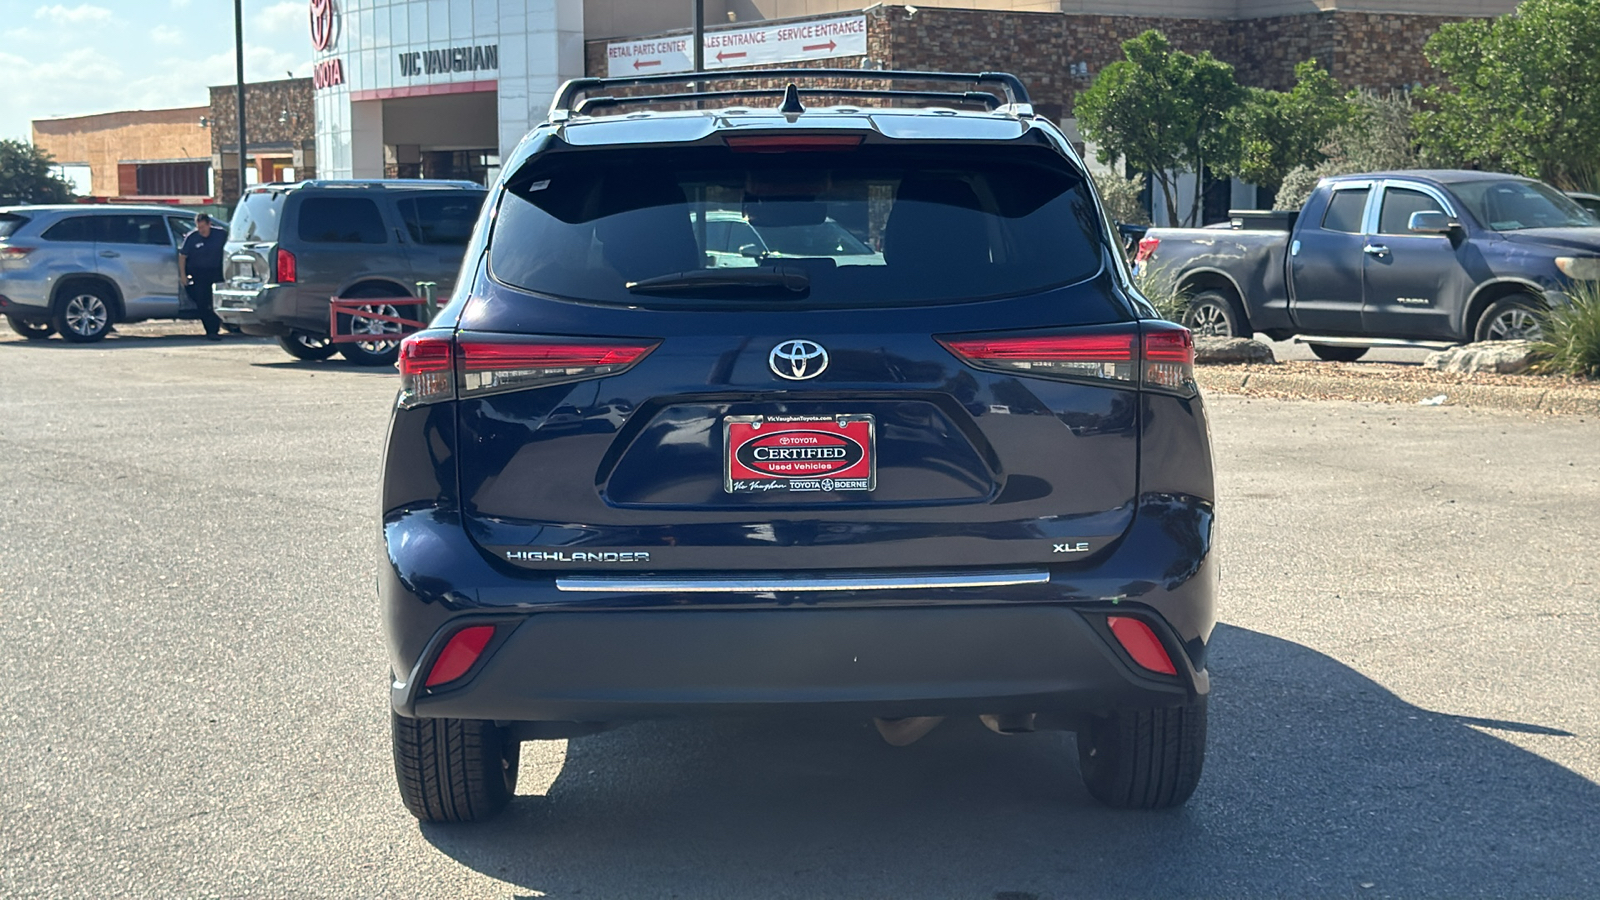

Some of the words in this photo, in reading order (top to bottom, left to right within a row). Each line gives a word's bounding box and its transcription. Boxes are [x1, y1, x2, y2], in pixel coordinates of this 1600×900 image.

[777, 26, 812, 41] SERVICE
[815, 20, 864, 37] ENTRANCE
[703, 36, 720, 48] ALES
[722, 32, 766, 46] ENTRANCE
[609, 47, 632, 58] RETAIL
[633, 44, 655, 56] PARTS
[657, 40, 686, 54] CENTER
[399, 51, 421, 77] VIC
[423, 44, 498, 75] VAUGHAN
[768, 463, 792, 471] Used
[794, 462, 832, 470] Vehicles
[790, 481, 821, 489] TOYOTA
[1052, 542, 1089, 553] XLE
[506, 551, 650, 562] HIGHLANDER
